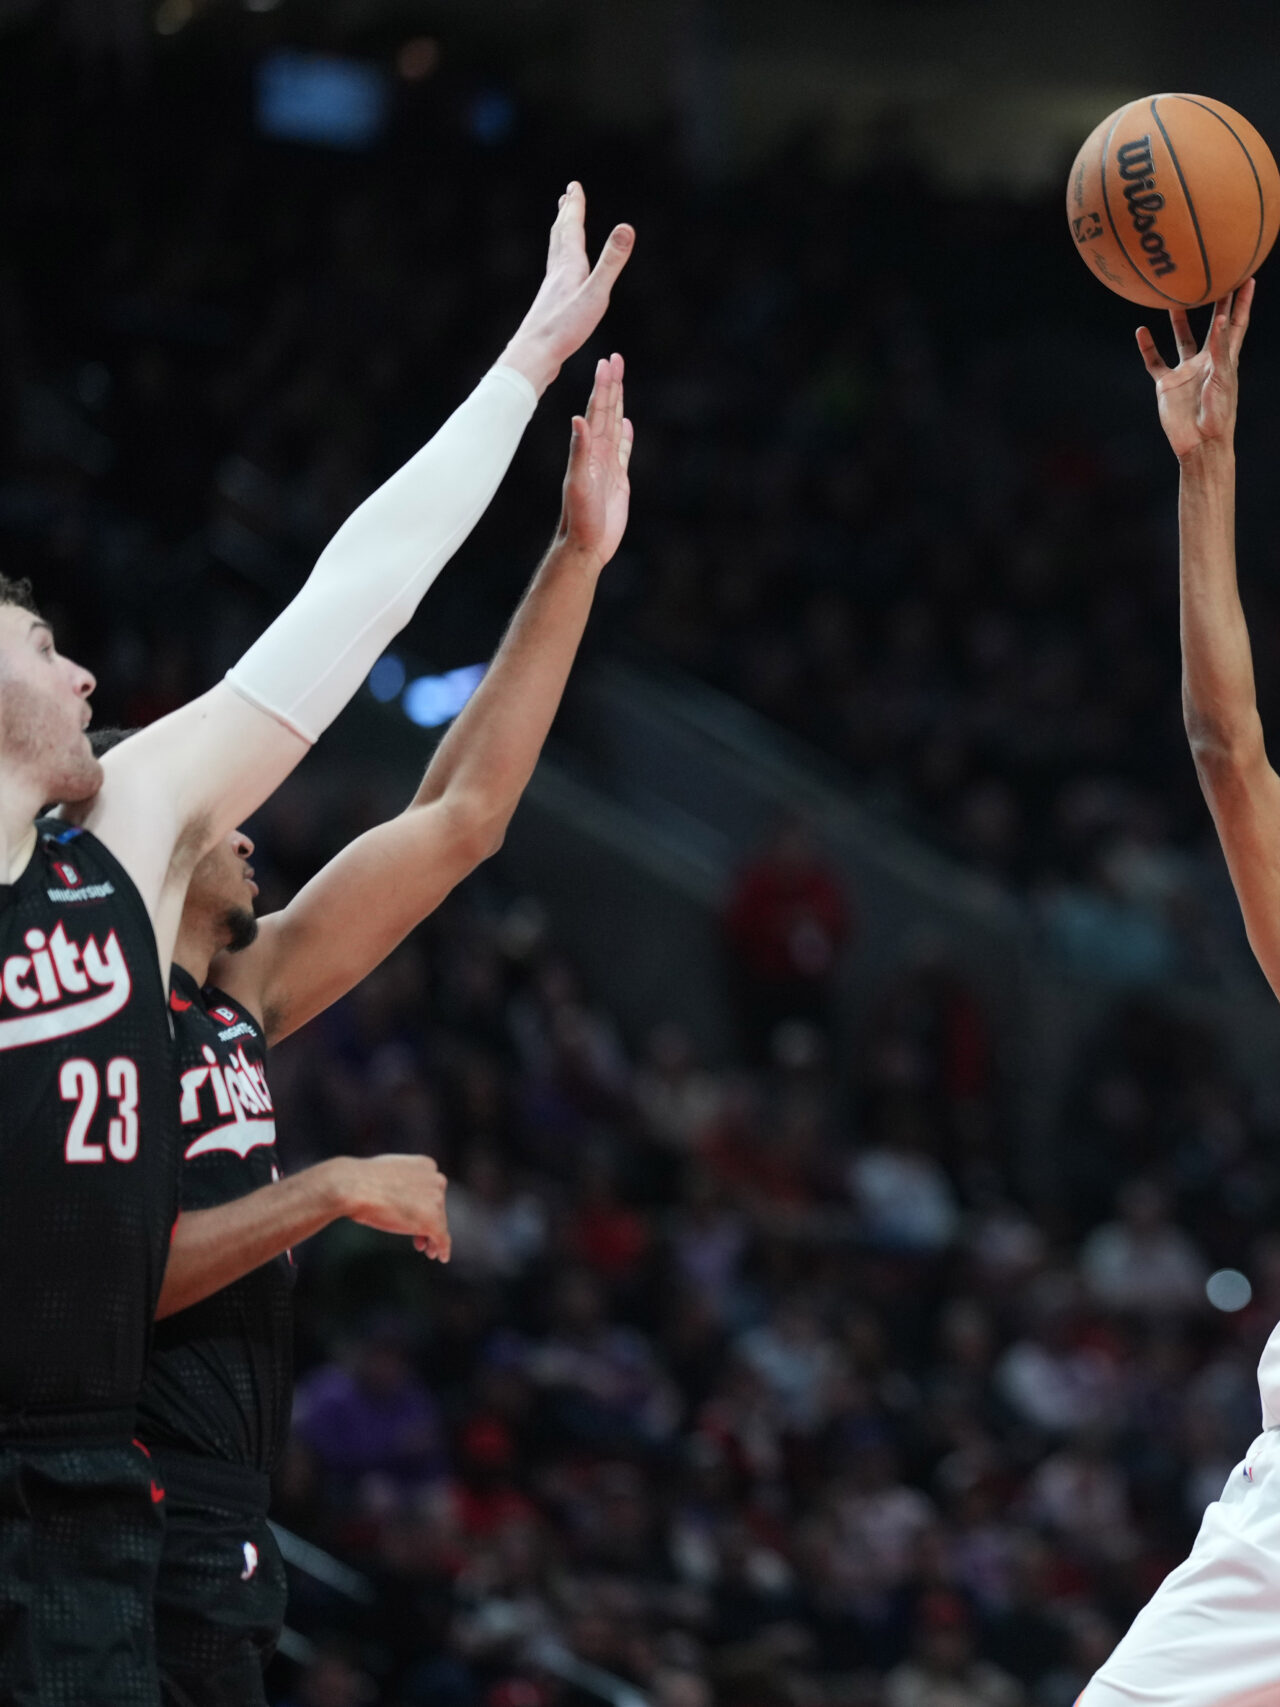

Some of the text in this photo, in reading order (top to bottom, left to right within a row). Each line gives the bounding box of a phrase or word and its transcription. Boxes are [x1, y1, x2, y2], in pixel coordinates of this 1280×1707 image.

[1116, 134, 1178, 279] Wilson
[1, 920, 132, 1040] city
[59, 1056, 140, 1164] 23
